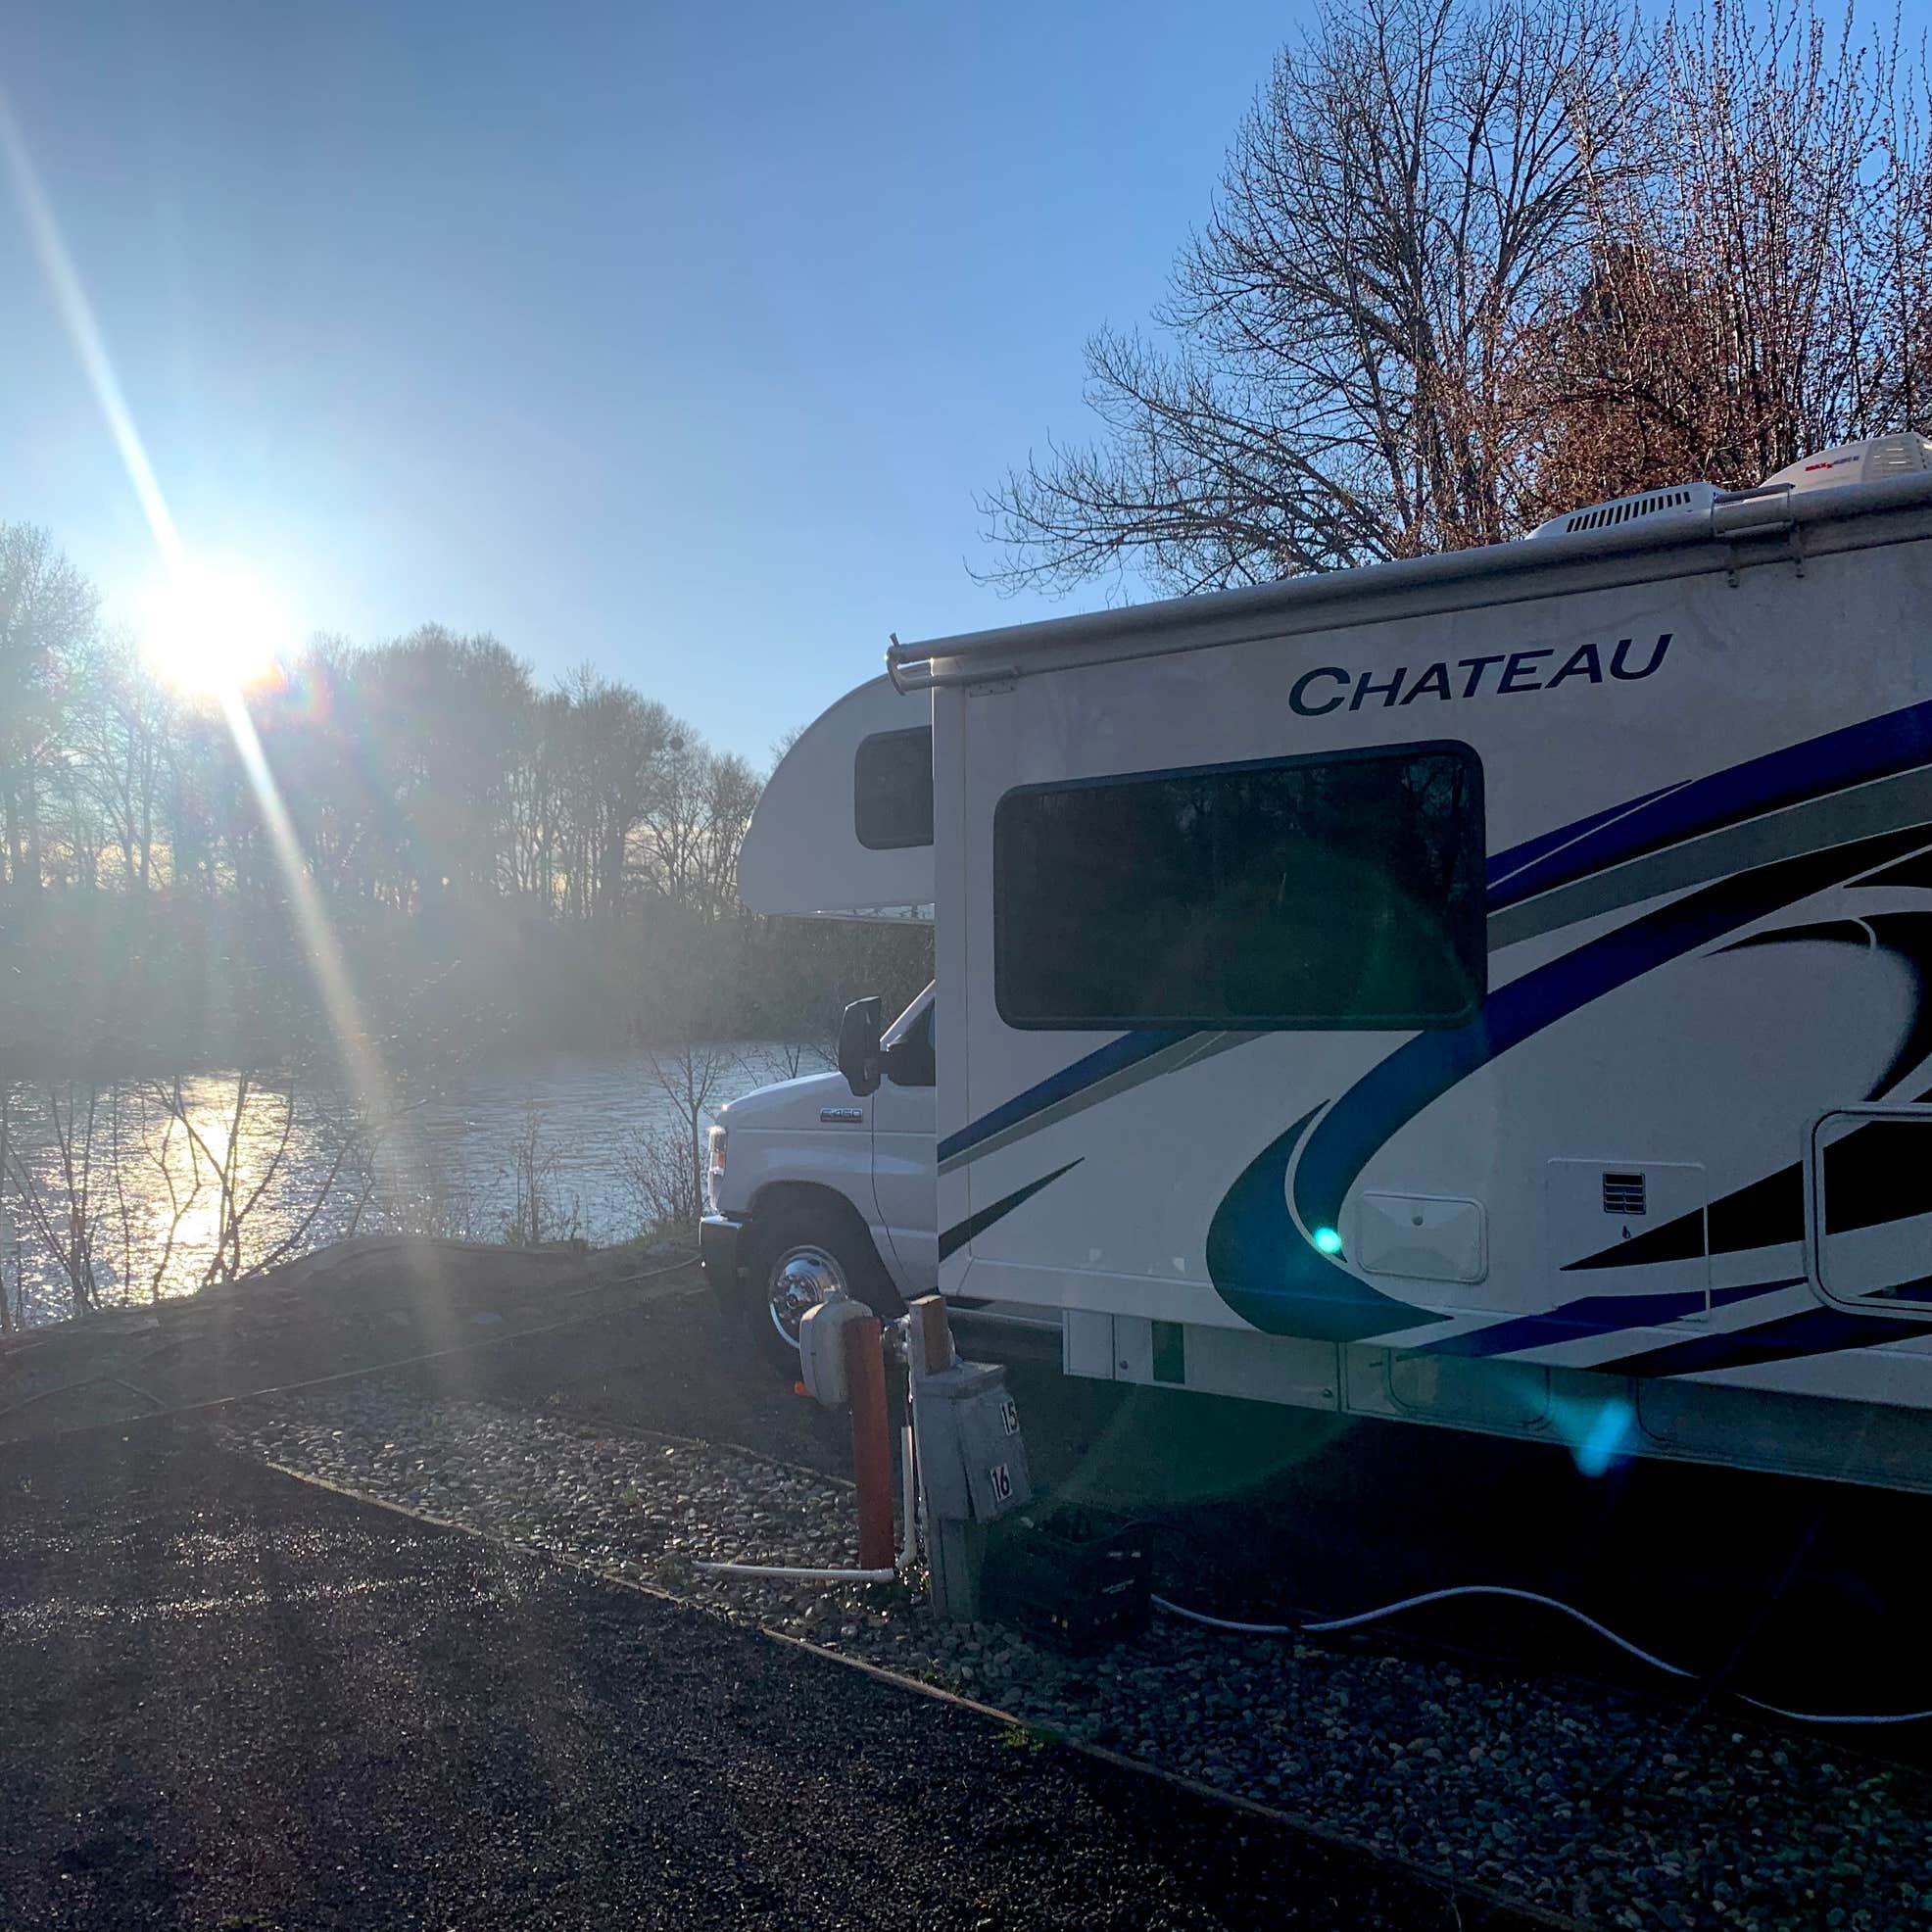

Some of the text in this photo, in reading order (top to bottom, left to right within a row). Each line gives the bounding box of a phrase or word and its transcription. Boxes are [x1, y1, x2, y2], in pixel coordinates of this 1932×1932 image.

[1288, 634, 1673, 716] CHATEAU
[1001, 1400, 1019, 1433] 15
[991, 1467, 1011, 1500] 16
